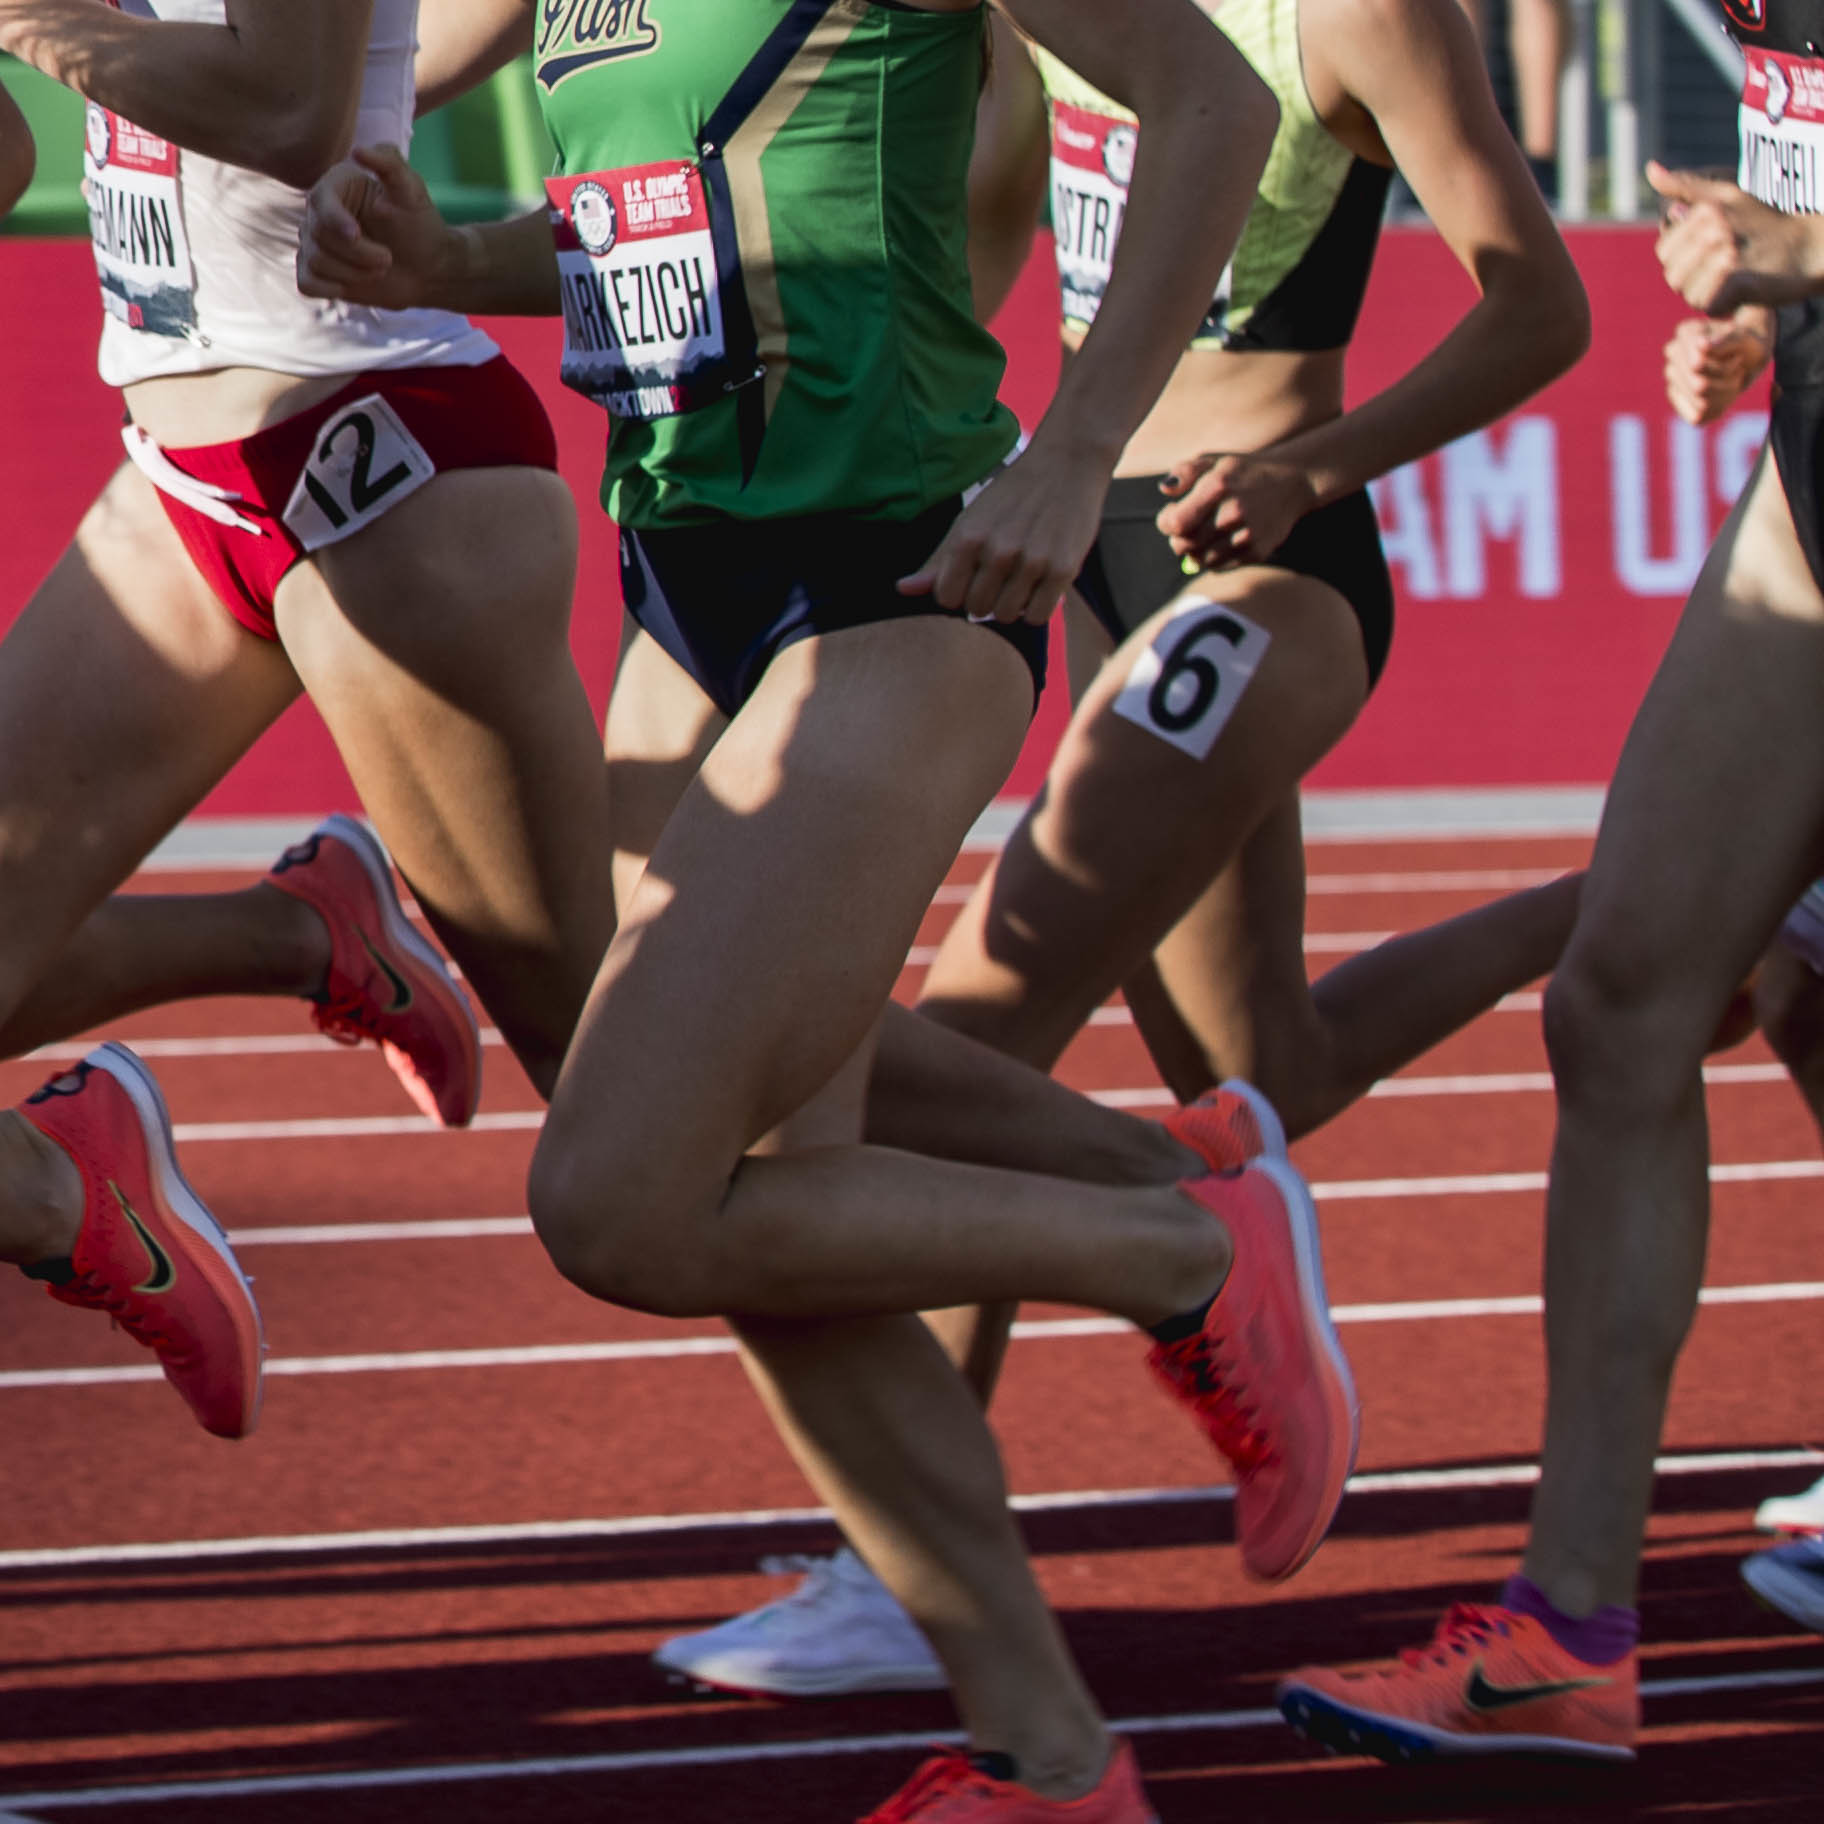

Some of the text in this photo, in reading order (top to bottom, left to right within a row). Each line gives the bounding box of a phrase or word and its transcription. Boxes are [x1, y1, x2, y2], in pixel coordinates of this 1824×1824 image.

[624, 194, 692, 226] TEAM TRIALS
[305, 412, 413, 530] 12
[1148, 614, 1247, 734] 6
